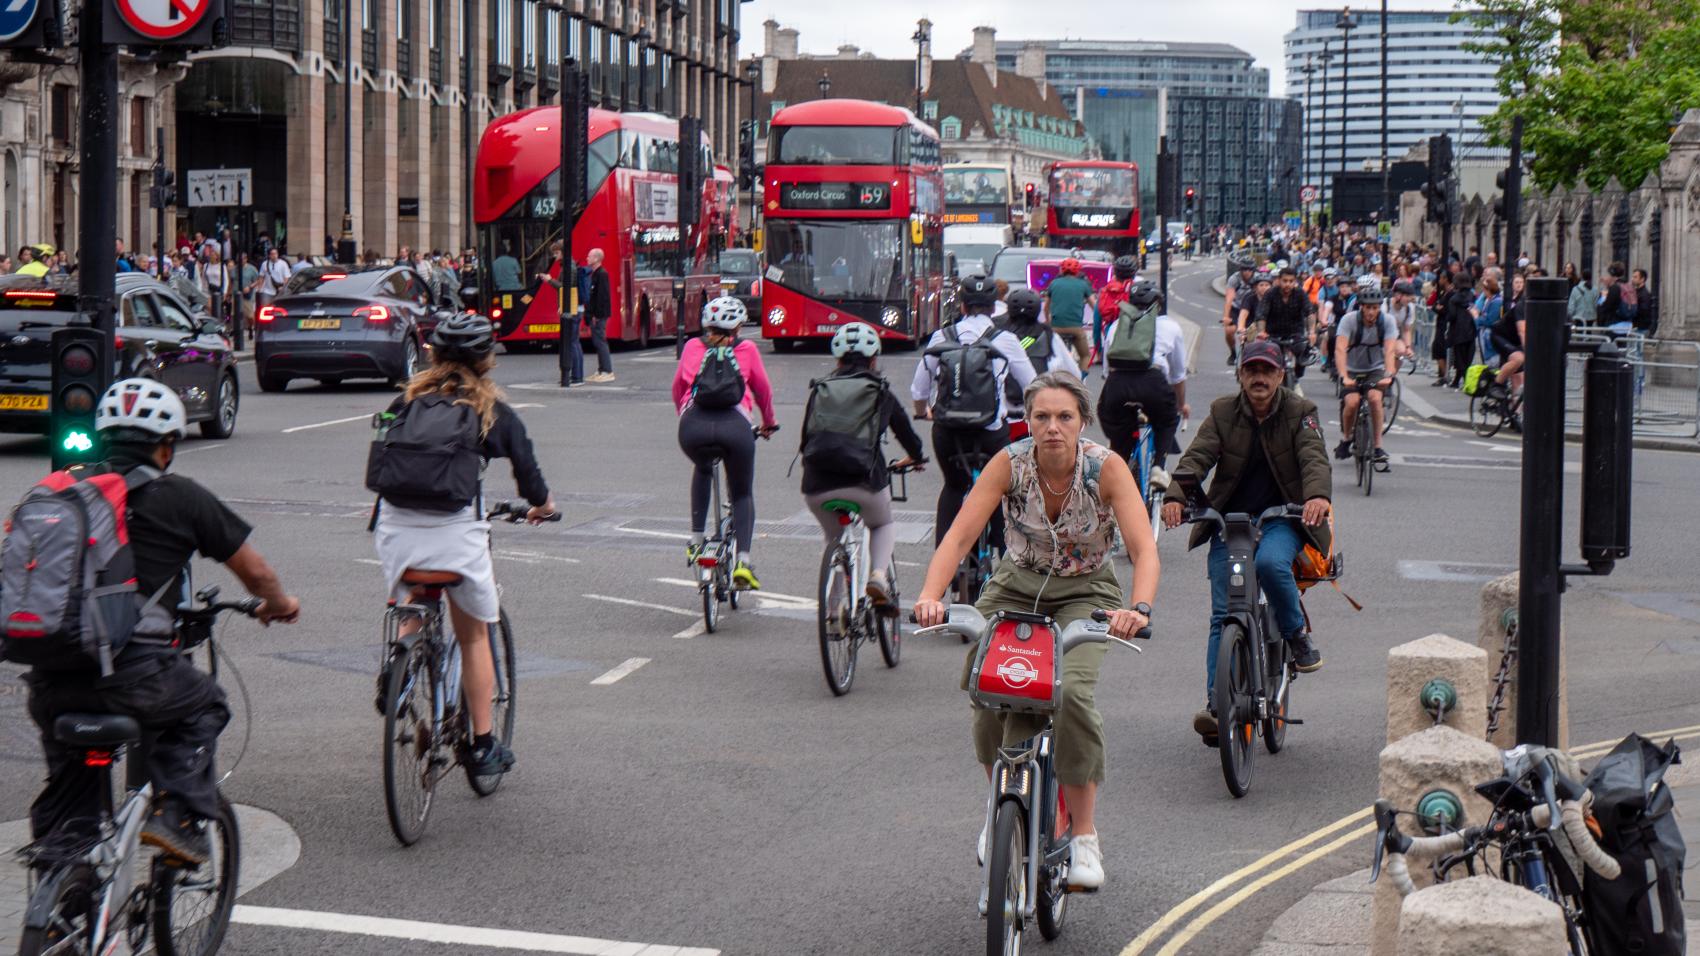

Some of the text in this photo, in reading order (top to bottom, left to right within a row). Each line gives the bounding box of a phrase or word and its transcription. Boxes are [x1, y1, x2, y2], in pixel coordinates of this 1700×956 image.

[790, 190, 846, 200] Oxford Circus
[860, 187, 883, 204] 159
[535, 198, 557, 216] 453
[1007, 645, 1042, 657] Santander
